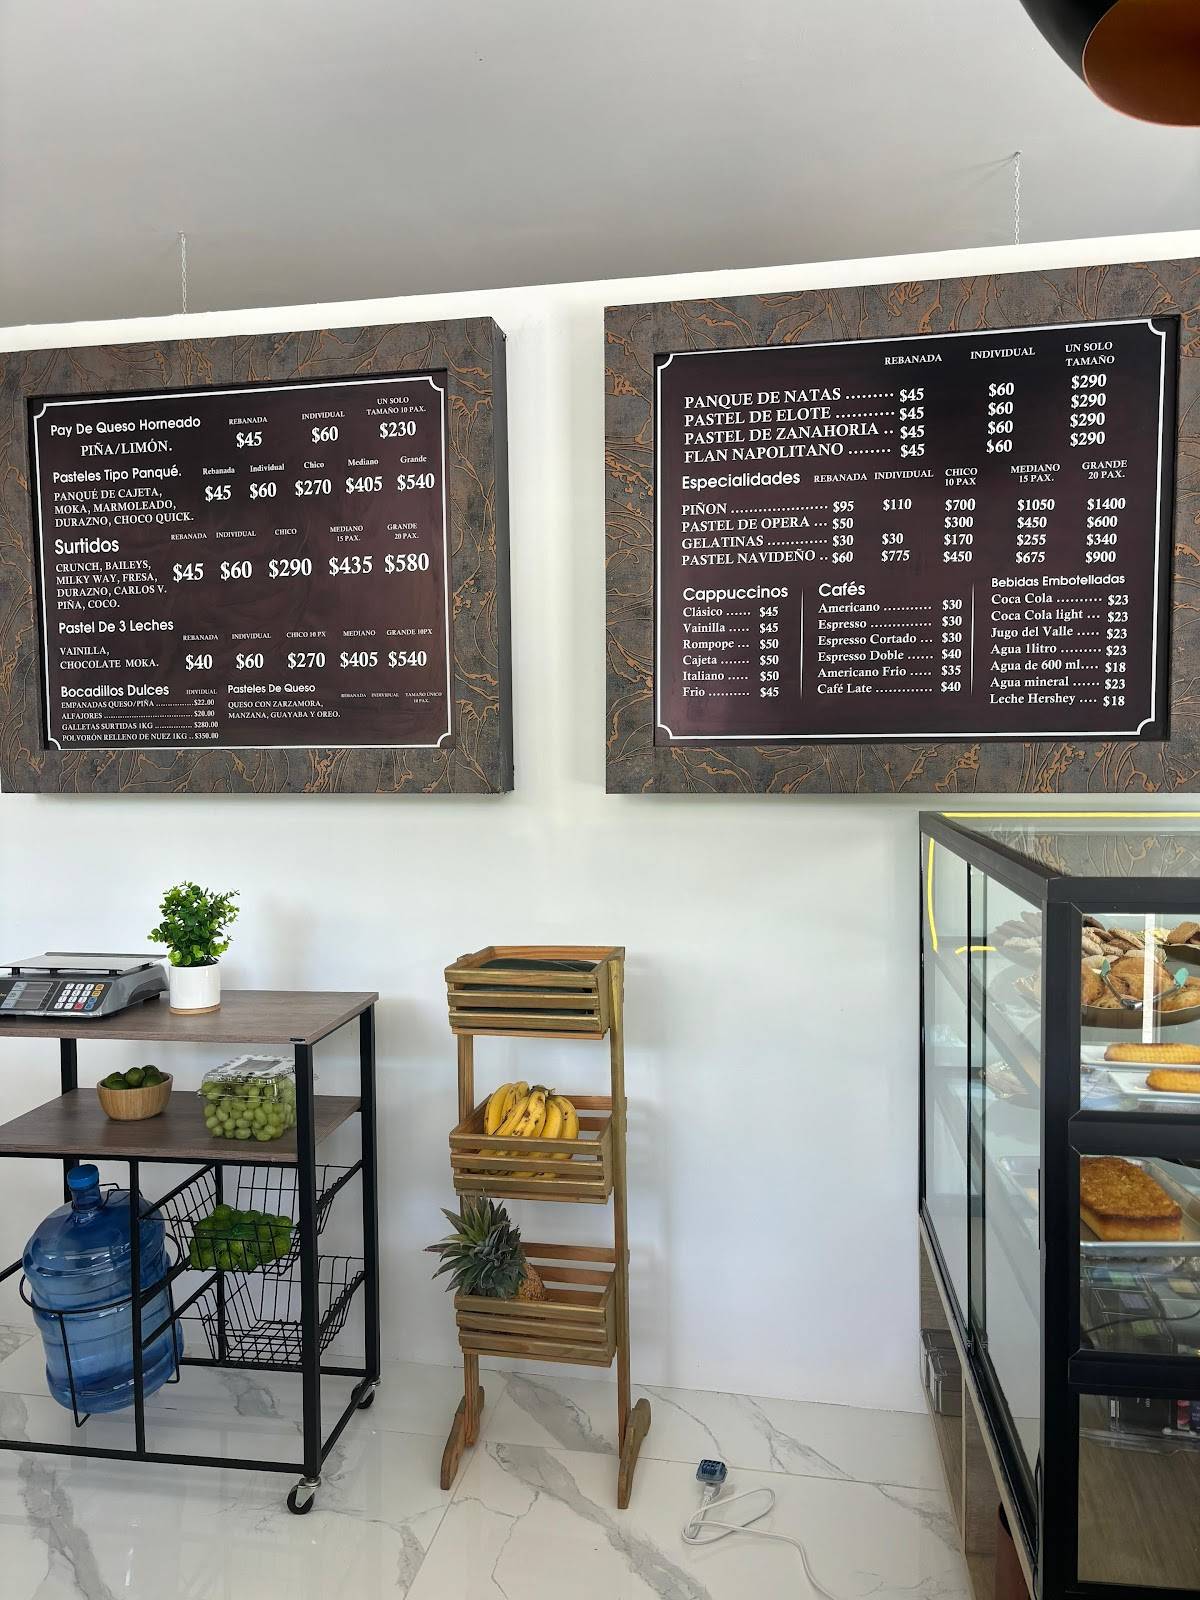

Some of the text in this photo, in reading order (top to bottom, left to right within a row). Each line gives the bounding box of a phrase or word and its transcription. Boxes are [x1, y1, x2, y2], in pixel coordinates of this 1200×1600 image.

[684, 374, 1107, 409] PANQUE DE NATAS $45 $60 $290
[302, 411, 345, 420] INDIVIDUAL
[366, 407, 399, 415] TAMAÑO
[684, 406, 831, 427] PASTEL DE ELOTE
[50, 416, 201, 438] Pay De Queso Horneado
[229, 417, 268, 425] REBANADA
[312, 426, 338, 444] $60
[380, 421, 416, 439] $230
[684, 422, 879, 445] PASTEL DE ZANAHORIA
[80, 438, 172, 456] PIÑA/LIMÓN.
[236, 432, 262, 449] $45
[400, 455, 427, 463] Grande
[684, 443, 843, 463] FLAN NAPOLITANO
[250, 463, 285, 472] Individual
[304, 461, 324, 469] Chico
[348, 458, 379, 466] Mediano
[1010, 464, 1060, 473] MEDIANO
[1082, 460, 1127, 470] GRANDE
[53, 464, 182, 483] Pasteles Tipo Panqué.
[202, 467, 235, 475] Rebanada
[945, 468, 978, 477] CHICO
[295, 479, 332, 497] $270
[346, 476, 382, 494] $405
[397, 473, 435, 492] $540
[682, 471, 800, 492] Especialidades
[54, 488, 162, 502] PANQUÉ DE CAJETA,
[54, 500, 176, 515] MOKA, MARMOLEADO,
[681, 498, 1126, 515] PIÑON $95 $700 $1050 $1400
[55, 512, 194, 527] DURAZNO, CHOCO QUICK.
[681, 516, 810, 532] PASTEL DE OPERA
[55, 537, 119, 555] Surtidos
[682, 535, 763, 549] GELATINAS
[385, 553, 429, 574] $580
[682, 548, 1116, 566] PASTEL NAVIDEÑO $675 $900
[56, 560, 151, 572] CRUNCH, BAILEYS,
[269, 558, 312, 579] $290
[329, 556, 372, 577] $435
[56, 572, 157, 585] MILKY WAY, FRESA,
[992, 574, 1125, 587] Bebidas Embotelladas
[57, 585, 167, 597] DURAZNO, CARLOS V.
[683, 585, 788, 603] Cappuccinos
[818, 581, 865, 597] Cafés
[57, 599, 120, 611] PIÑA, COCO.
[818, 599, 962, 613] Americano $30
[991, 592, 1129, 606] Coca Cola $23
[683, 606, 778, 618] Clásico $45
[59, 619, 174, 634] Pastel De 3 Leches
[683, 622, 778, 634] Vainilla $45
[818, 616, 962, 631] Espresso $30
[990, 626, 1073, 640] Jugo del Valle
[683, 640, 734, 651] Rompope
[818, 633, 917, 648] Espresso Cortado
[60, 646, 109, 656] VAINILLA,
[990, 644, 1021, 657] Agua
[60, 659, 159, 669] CHOCOLATE MOKA.
[186, 654, 213, 671] $40
[683, 655, 717, 667] Cajeta
[990, 660, 1021, 673] Agua
[1025, 660, 1038, 670] de
[1041, 659, 1062, 670] 600
[1105, 662, 1126, 674] $18
[683, 671, 724, 681] Italiano
[61, 684, 169, 697] Bocadillos Dulces
[228, 684, 316, 693] Pasteles De Queso
[683, 687, 705, 696] Frio
[817, 683, 872, 694] Café Late
[61, 701, 107, 709] EMPANADAS
[108, 699, 154, 709] QUESO/PIÑA
[990, 693, 1125, 707] Leche Hershey $18
[62, 733, 102, 741] POLVORÓN
